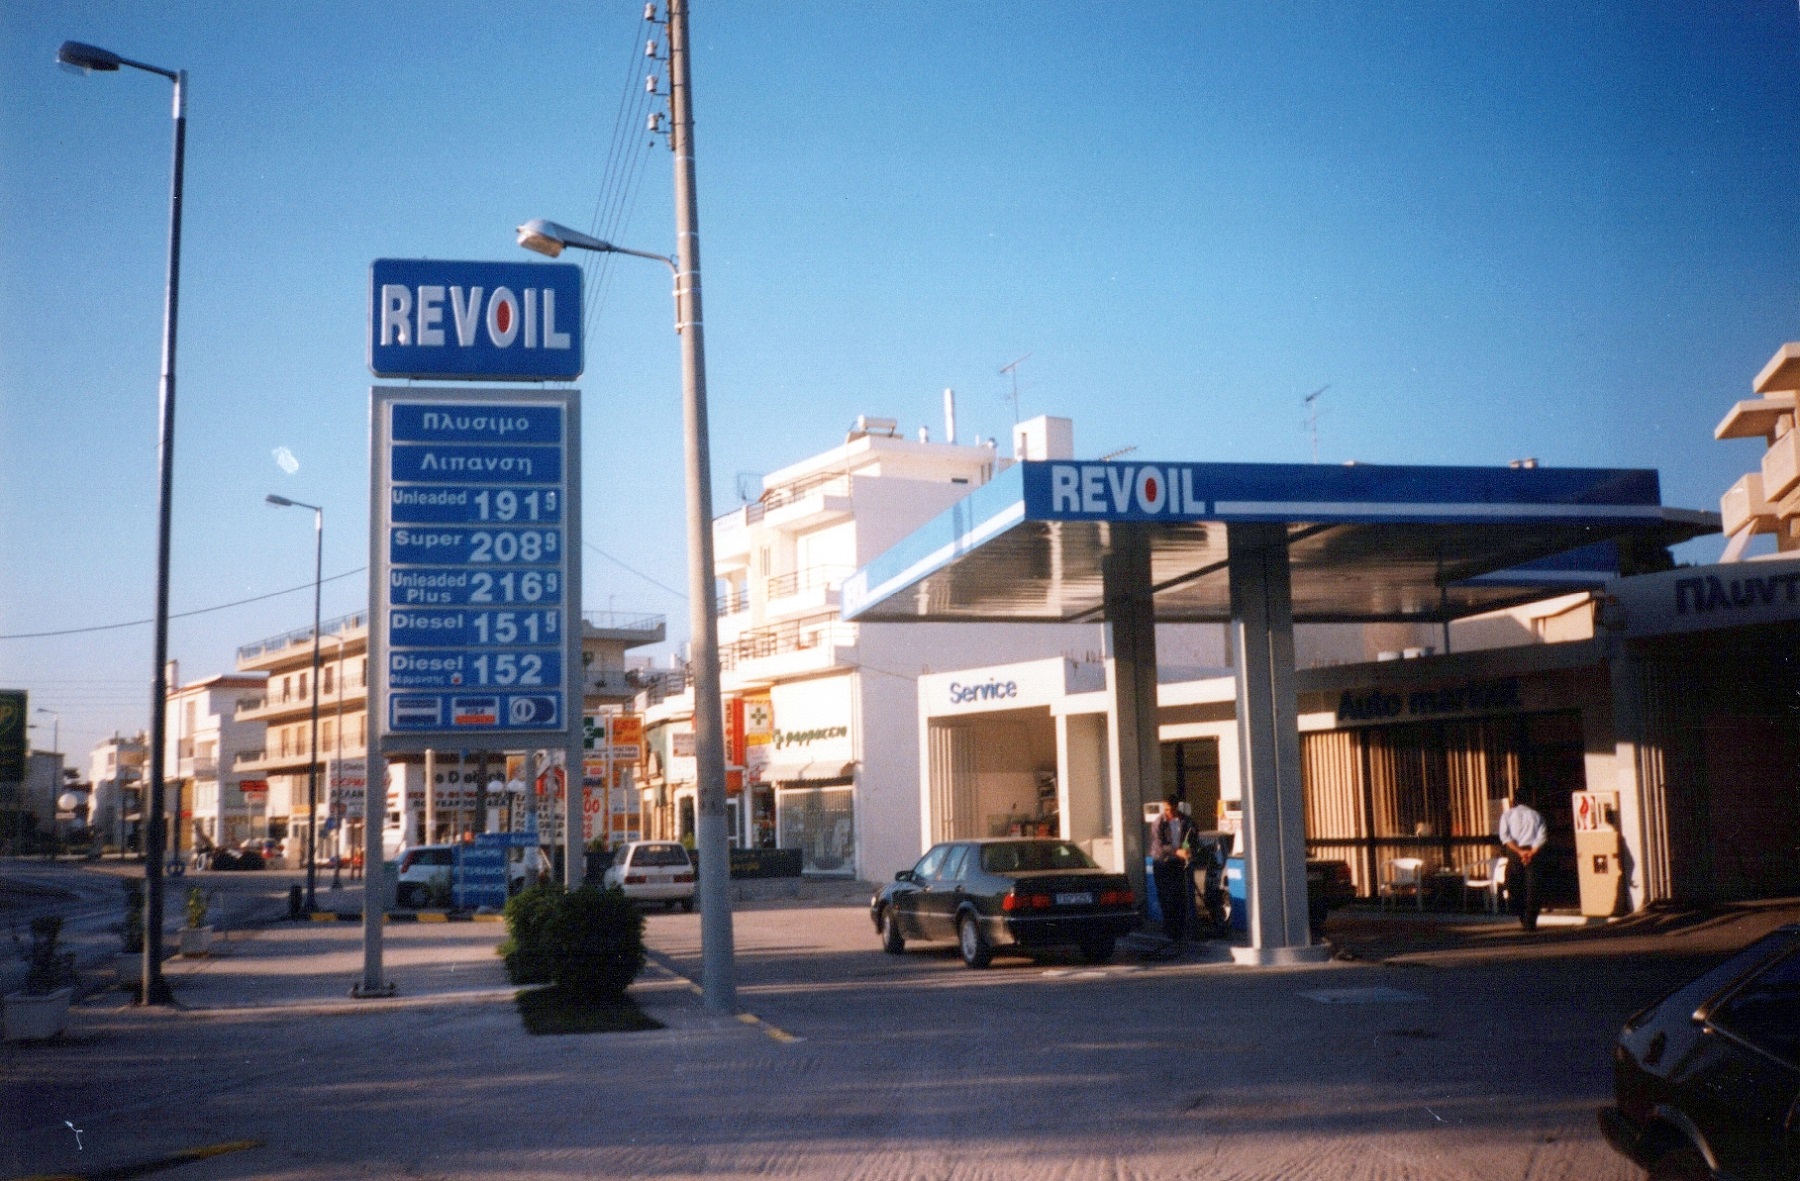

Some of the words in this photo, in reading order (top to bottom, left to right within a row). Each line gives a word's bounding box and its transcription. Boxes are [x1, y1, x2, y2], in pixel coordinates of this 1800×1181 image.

[380, 284, 571, 349] REVOIL
[392, 489, 467, 505] Unleaded
[474, 490, 540, 520] 191
[1051, 464, 1206, 515] REVOIL
[394, 530, 462, 549] Super
[468, 531, 543, 562] 208
[391, 573, 467, 588] Unleaded
[470, 572, 543, 602] 216
[406, 588, 451, 602] Plus
[391, 613, 464, 630] Diesel
[474, 613, 540, 643] 151
[391, 655, 464, 672] Diesel
[473, 654, 543, 685] 152
[949, 680, 1018, 705] Service
